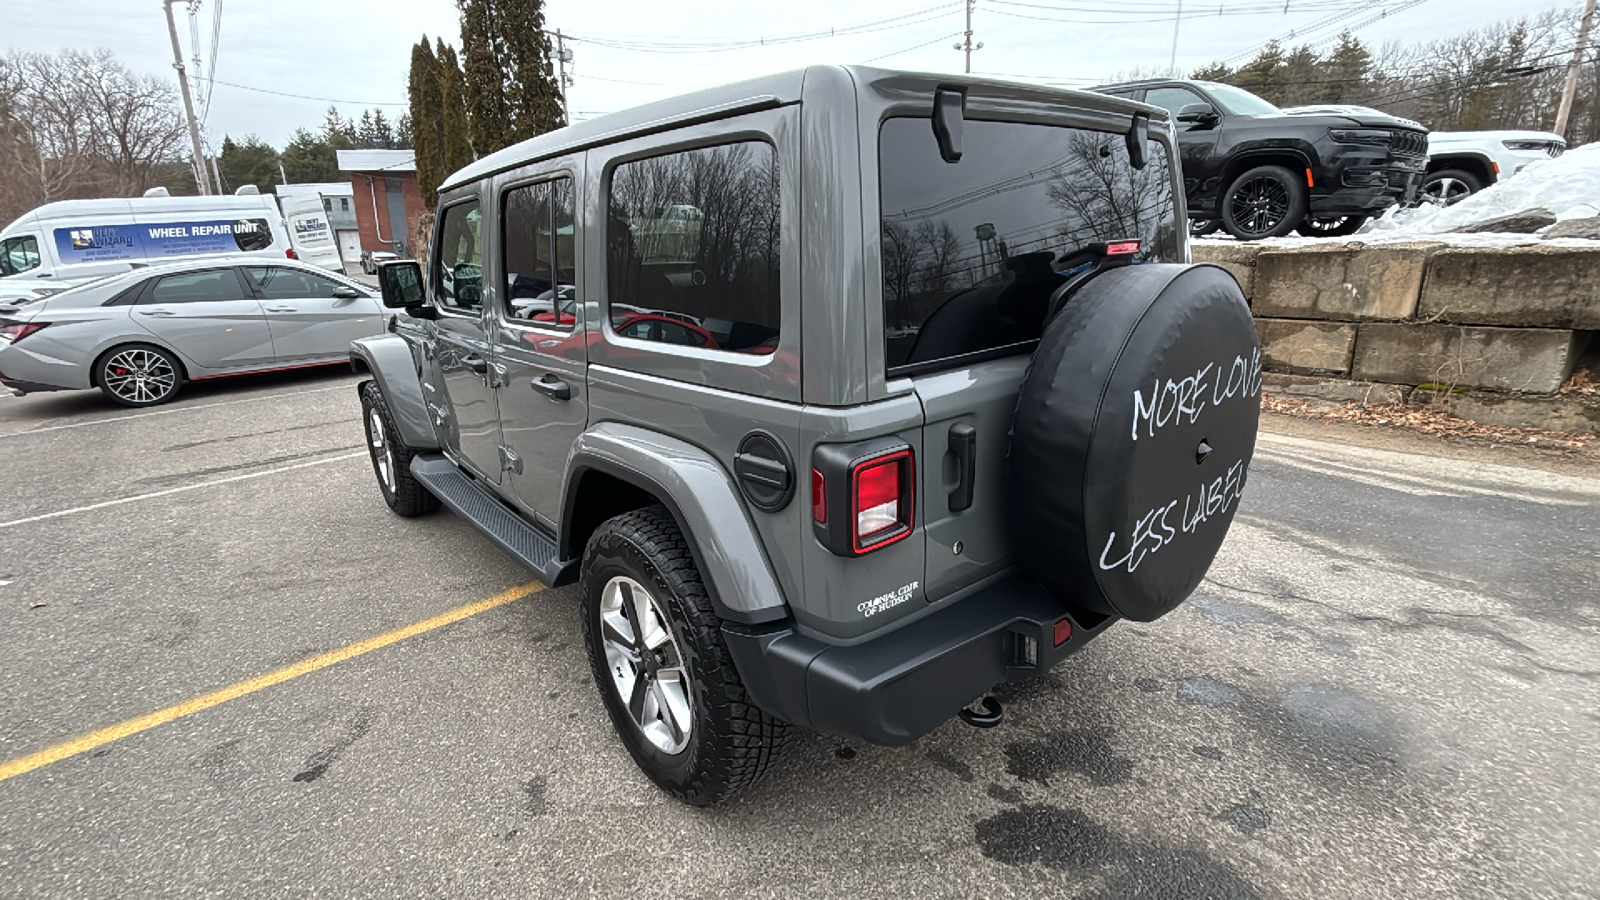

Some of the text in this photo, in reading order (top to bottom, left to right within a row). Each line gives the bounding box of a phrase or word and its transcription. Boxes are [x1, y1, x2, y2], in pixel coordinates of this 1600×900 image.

[95, 236, 133, 247] WIZARD
[148, 227, 189, 239] WHEEL
[191, 225, 231, 236] REPAIR
[233, 223, 259, 234] UNIT
[1132, 346, 1262, 440] MORE LOVE
[1099, 459, 1243, 573] LESS LABEL
[856, 581, 919, 612] COLONIAL CDJR
[864, 591, 913, 617] OF HUDSON
